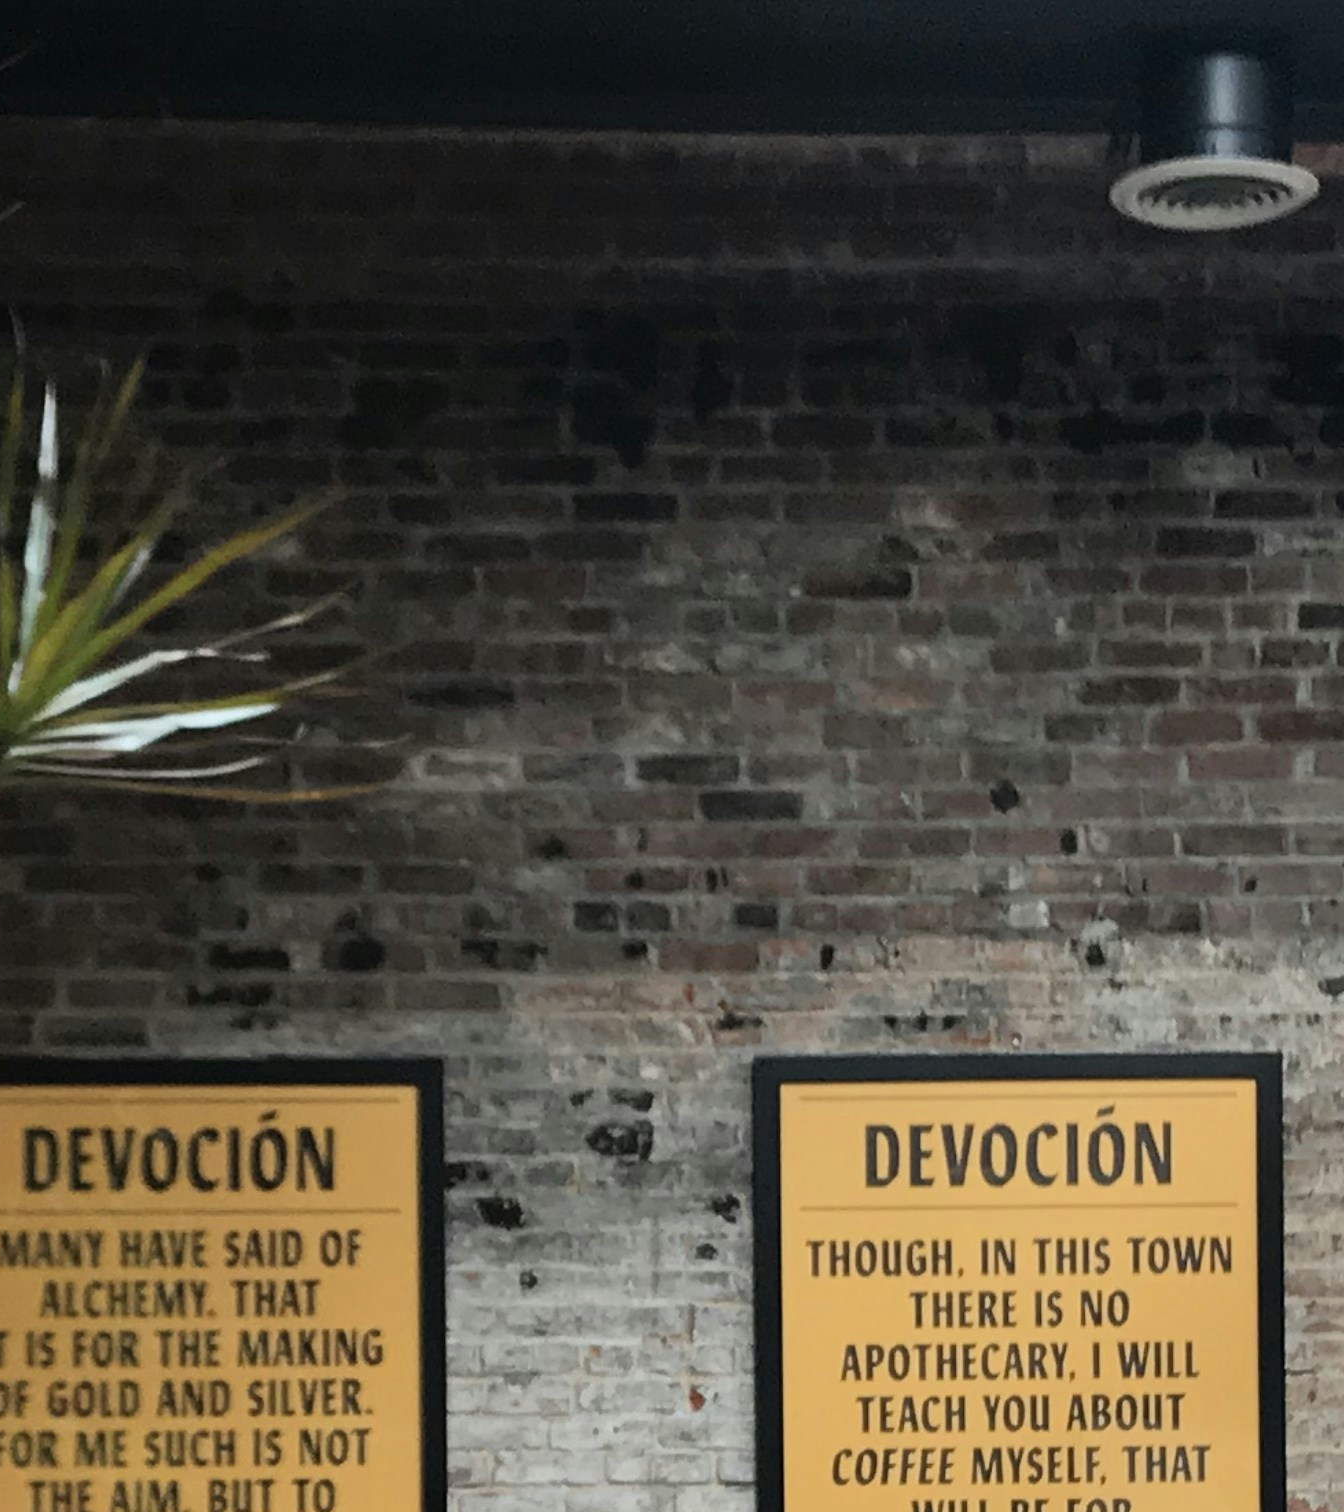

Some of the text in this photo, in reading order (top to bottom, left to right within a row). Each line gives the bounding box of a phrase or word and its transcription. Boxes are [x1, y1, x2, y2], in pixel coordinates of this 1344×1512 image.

[21, 1109, 337, 1194] DEVOCIÓN
[864, 1105, 1173, 1188] DEVOCIÓN
[118, 1229, 209, 1269] HAVE
[222, 1228, 305, 1269] SAID
[318, 1228, 363, 1268] OF
[805, 1236, 1234, 1278] THOUGH, IN THIS TOWN
[229, 1278, 322, 1318] THAT
[908, 1289, 1131, 1329] THERE IS NO
[23, 1330, 58, 1371] IS
[70, 1329, 142, 1370] FOR
[154, 1328, 222, 1369] THE
[236, 1328, 385, 1367] MAKING
[840, 1340, 1201, 1382] APOTHECARY, I WILL
[44, 1378, 143, 1419] GOLD
[155, 1378, 233, 1418] AND
[855, 1393, 1187, 1434] TEACH YOU ABOUT
[72, 1428, 129, 1469] ME
[142, 1428, 238, 1469] SUCH
[251, 1427, 284, 1467] IS
[298, 1427, 372, 1467] NOT
[831, 1445, 1212, 1486] COFFEE MYSELF, THAT
